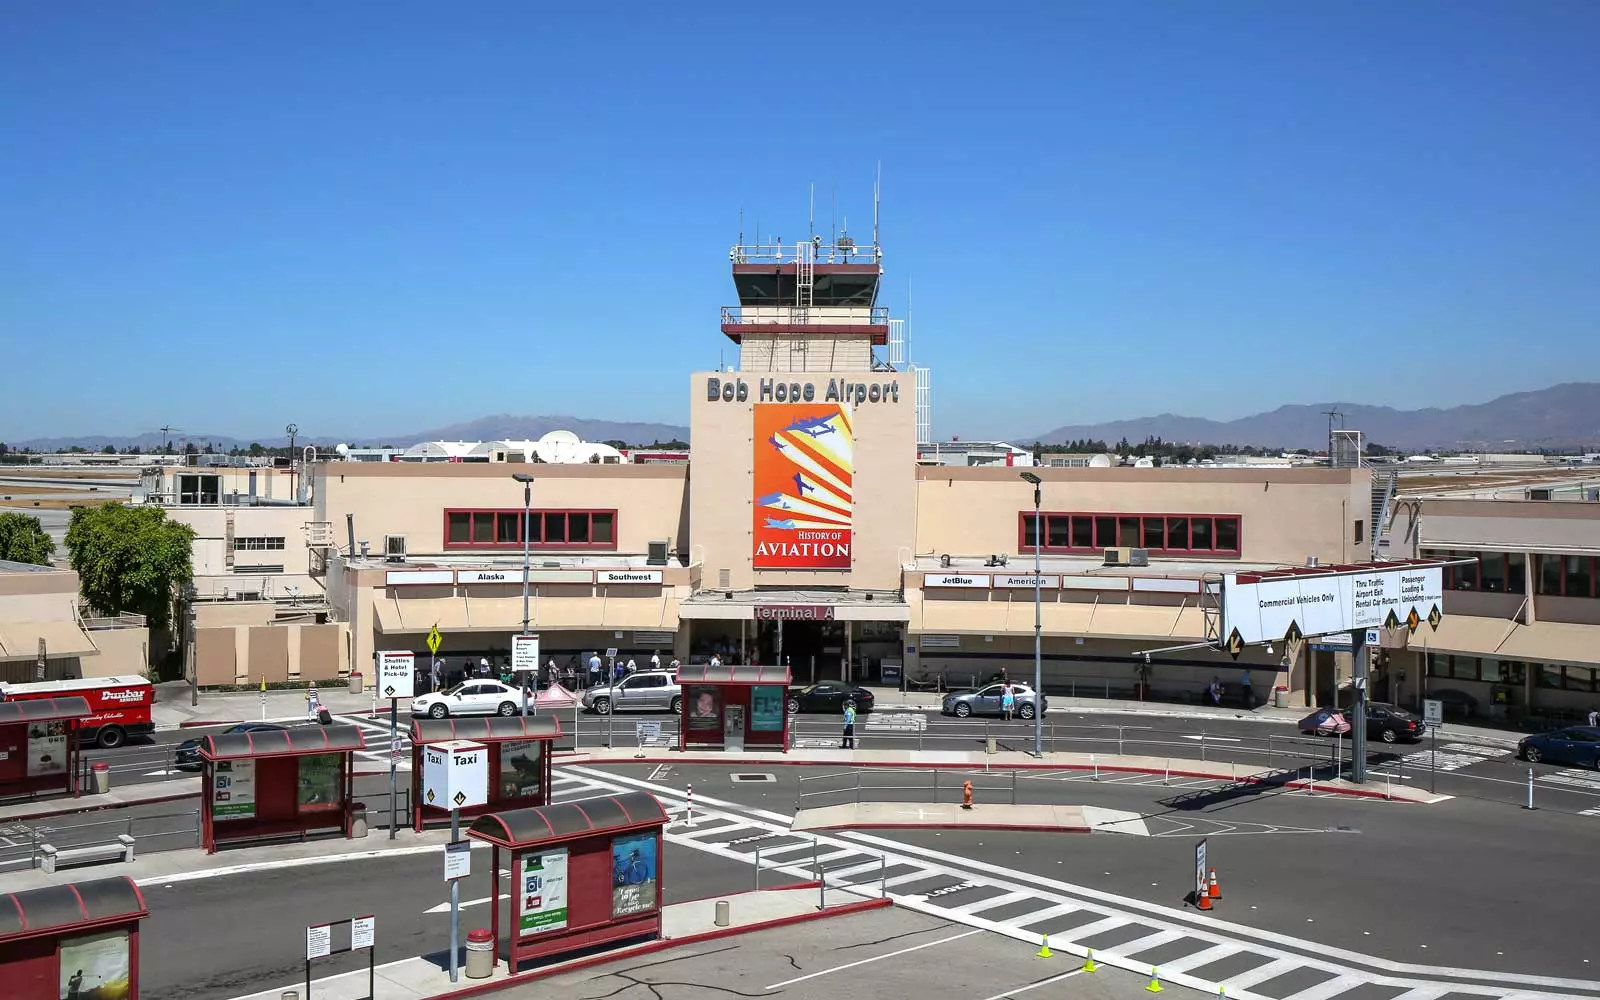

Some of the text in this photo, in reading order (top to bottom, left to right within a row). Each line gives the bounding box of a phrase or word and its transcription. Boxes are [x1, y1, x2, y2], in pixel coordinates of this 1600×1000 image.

[707, 378, 899, 406] Bob Hope Airport
[798, 531, 842, 540] HISTORY OF
[756, 541, 849, 557] AVIATION
[477, 573, 505, 581] Alaska
[608, 573, 652, 581] Southwest
[942, 577, 973, 585] JetBlue
[1402, 576, 1426, 584] Passenger
[1356, 579, 1384, 588] Thru Traffic
[1356, 588, 1384, 599] Airport Exit
[1402, 595, 1424, 603] Unloading
[1260, 593, 1335, 608] Commercial Vehicles Only
[1356, 600, 1372, 608] Rental
[1382, 597, 1399, 605] Return
[754, 606, 834, 618] Terminal A
[102, 689, 145, 701] Dunbar
[427, 753, 442, 765] Taxi
[454, 754, 477, 766] Taxi
